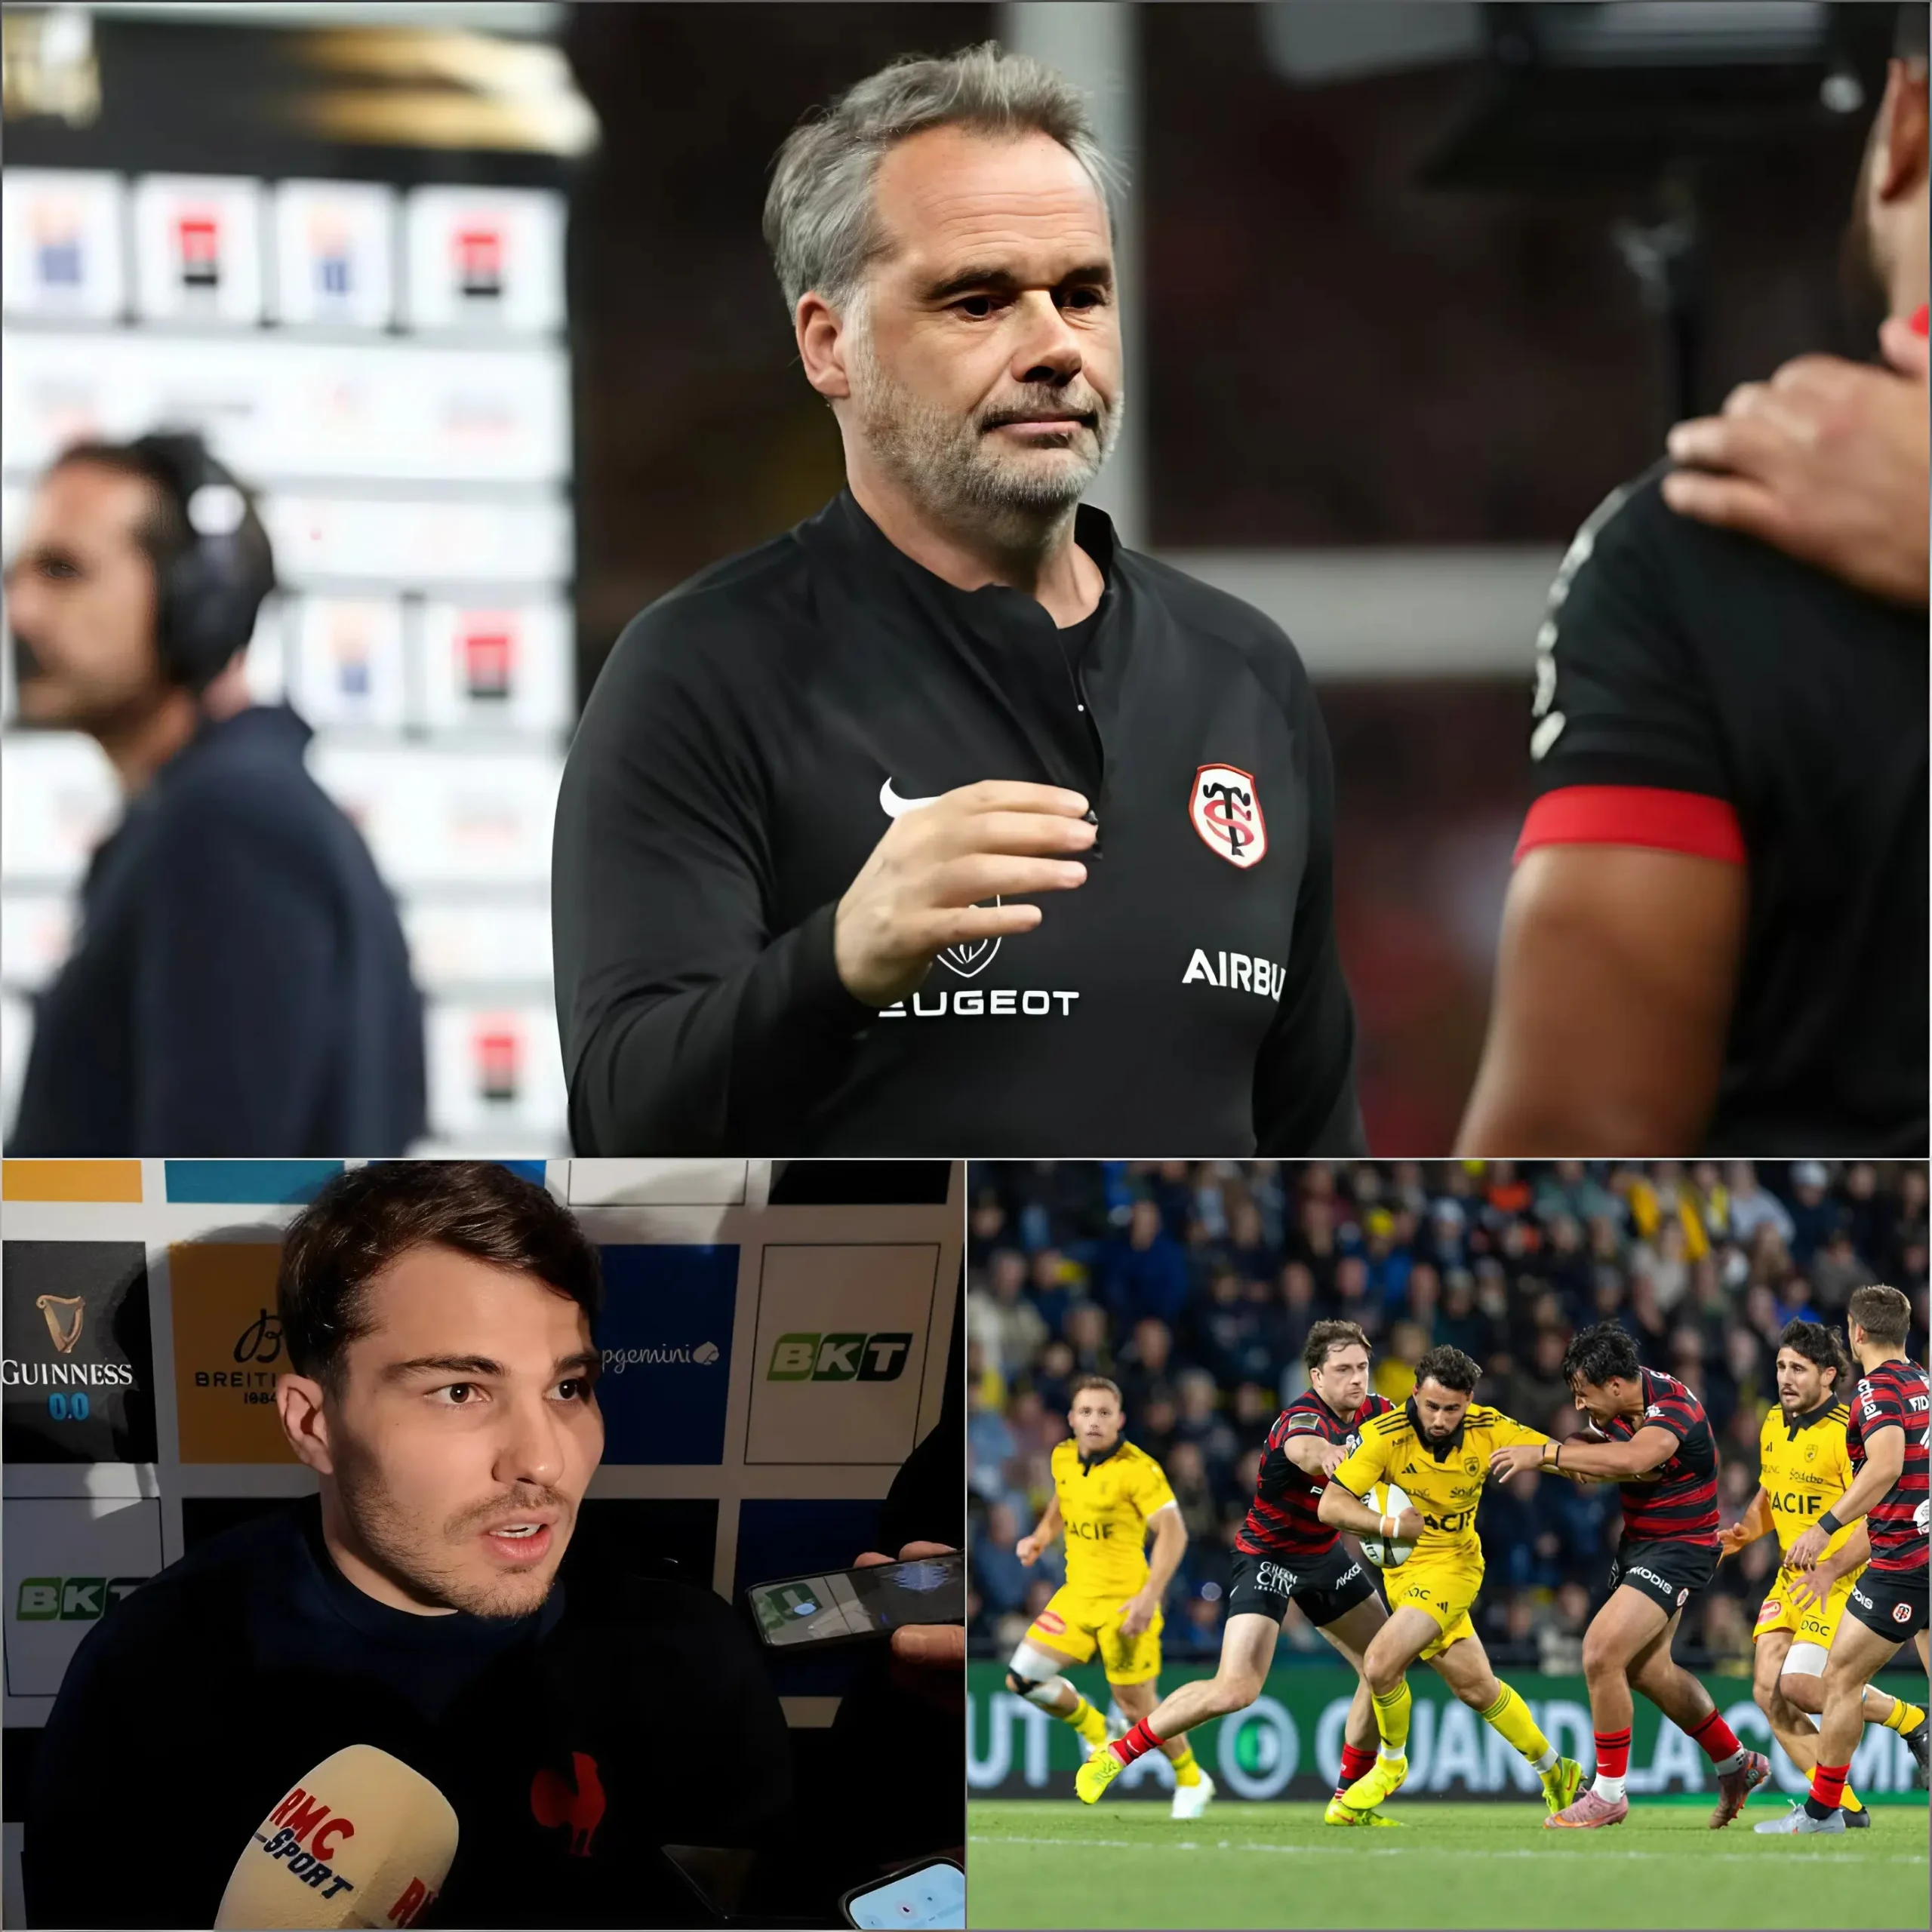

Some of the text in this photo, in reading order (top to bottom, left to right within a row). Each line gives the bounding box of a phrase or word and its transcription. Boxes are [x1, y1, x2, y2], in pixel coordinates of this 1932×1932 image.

[601, 1343, 691, 1374] pgemini
[770, 1339, 909, 1376] BKT
[2, 1359, 134, 1386] GUINNESS
[48, 1392, 90, 1420] 0.0
[1767, 1491, 1823, 1515] ACIF
[1064, 1520, 1115, 1540] ACIF
[269, 1787, 355, 1862] RMC
[263, 1826, 355, 1900] SPORT
